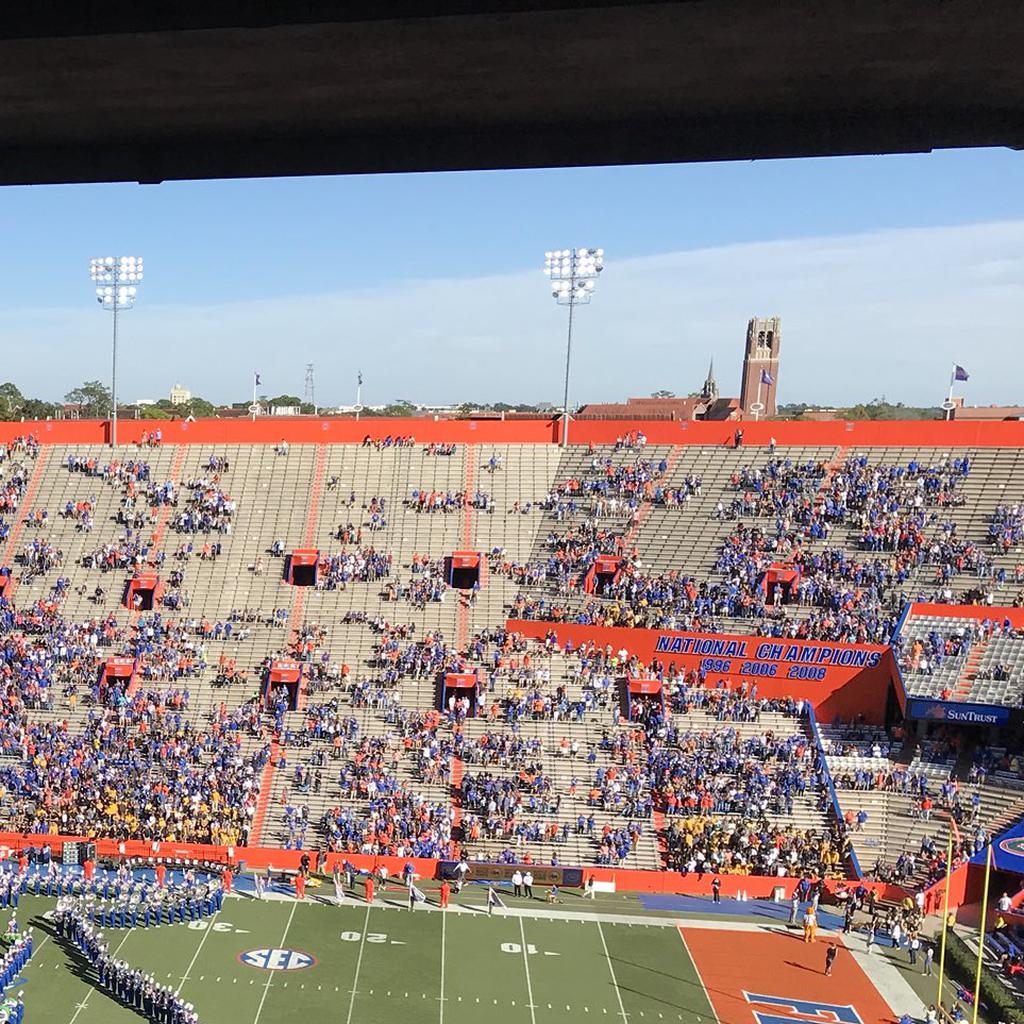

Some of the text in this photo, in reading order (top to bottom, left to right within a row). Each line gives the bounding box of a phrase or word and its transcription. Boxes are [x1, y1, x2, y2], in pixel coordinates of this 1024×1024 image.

[656, 636, 882, 668] NATIONAL CHAMPIONS
[741, 661, 777, 676] 2006
[788, 665, 827, 681] 2008
[245, 949, 314, 970] SEC
